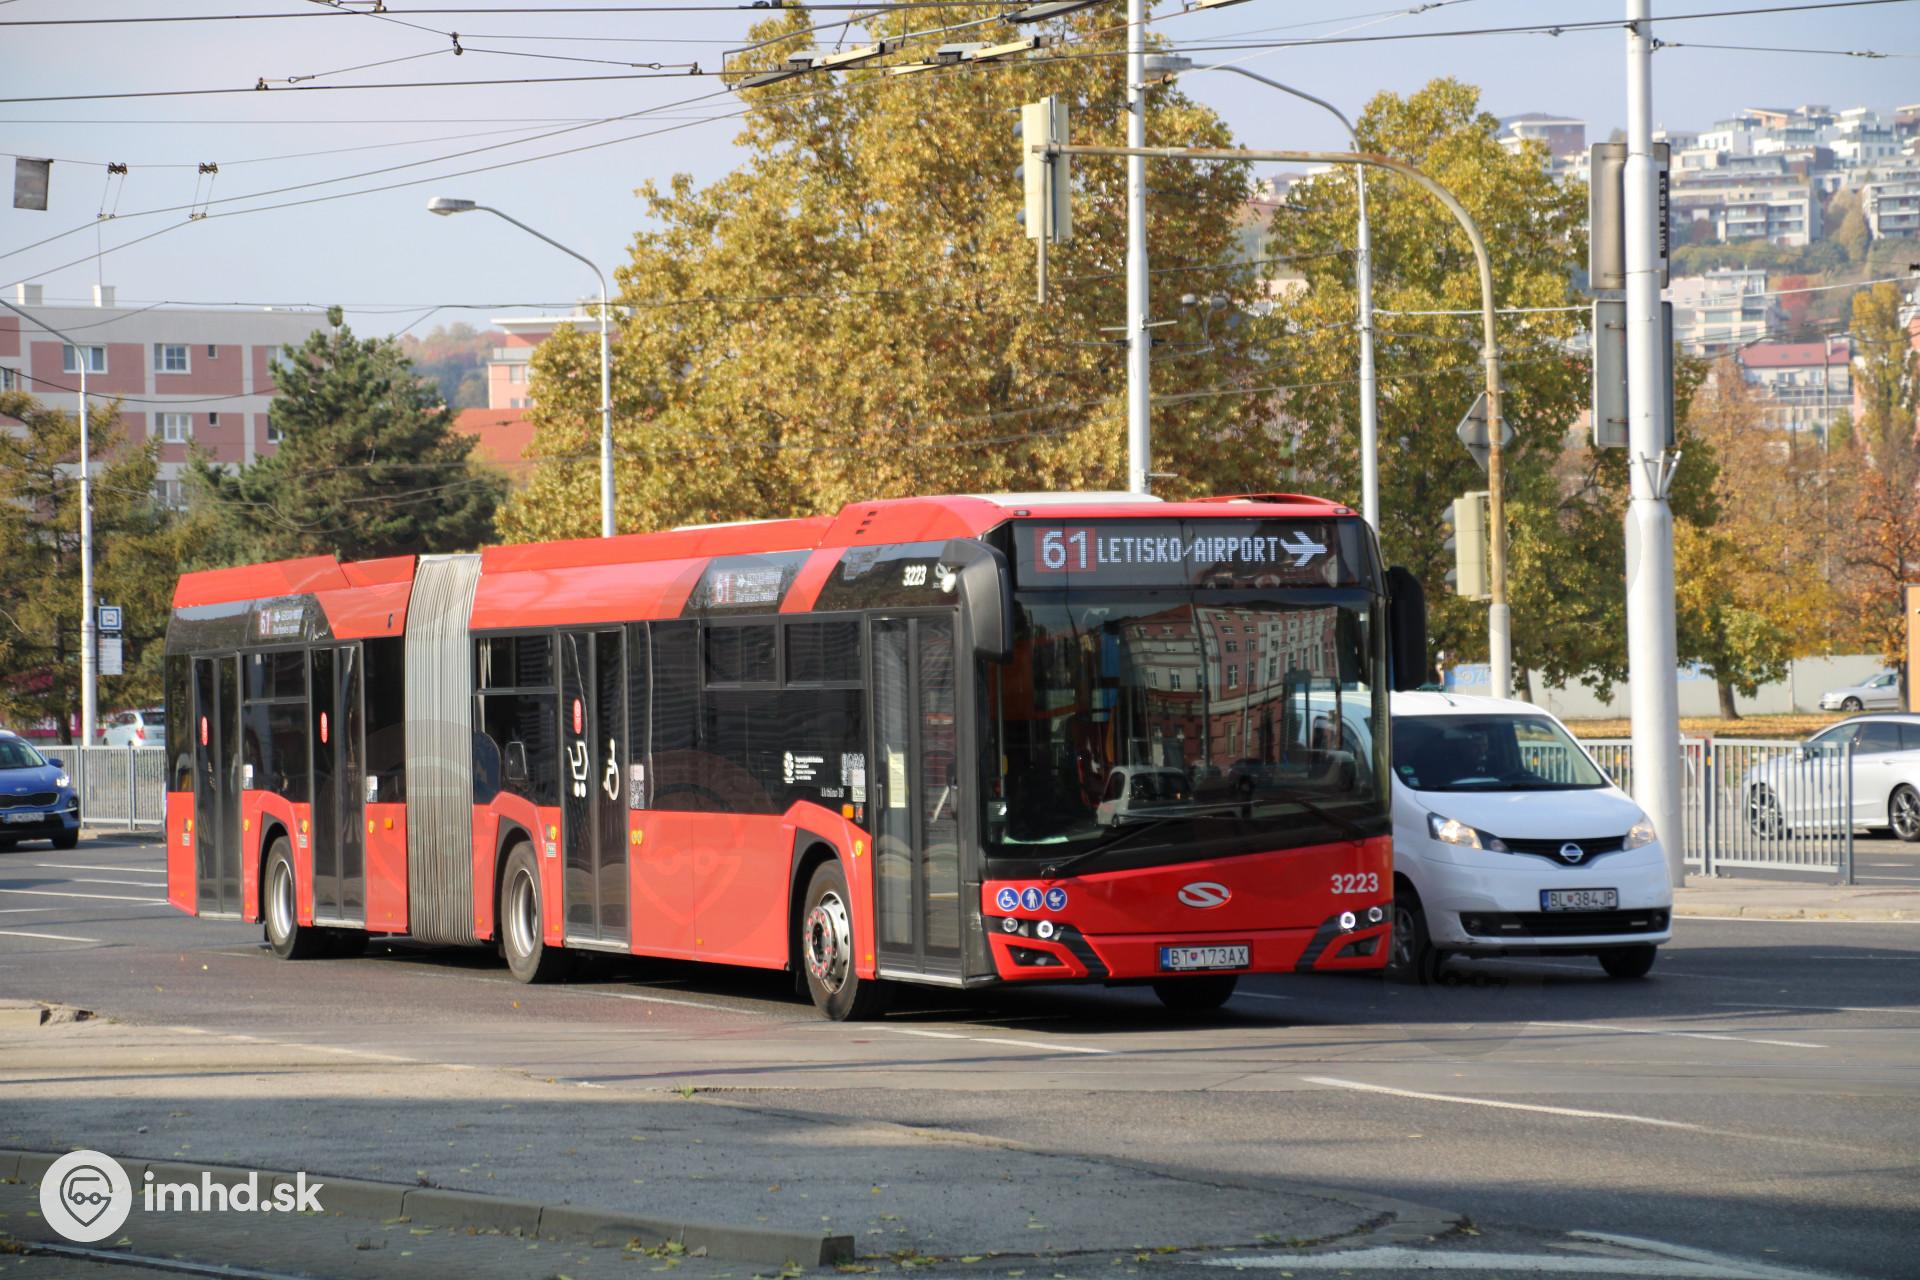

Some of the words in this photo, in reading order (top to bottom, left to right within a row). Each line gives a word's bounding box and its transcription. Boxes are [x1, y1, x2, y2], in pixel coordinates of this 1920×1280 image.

[1043, 531, 1087, 569] 61
[902, 564, 927, 586] 3223
[716, 574, 730, 603] 61
[260, 610, 270, 634] 61
[1330, 872, 1379, 895] 3223
[1551, 892, 1568, 907] BL
[1171, 949, 1189, 966] BT
[1200, 948, 1246, 965] 173AX
